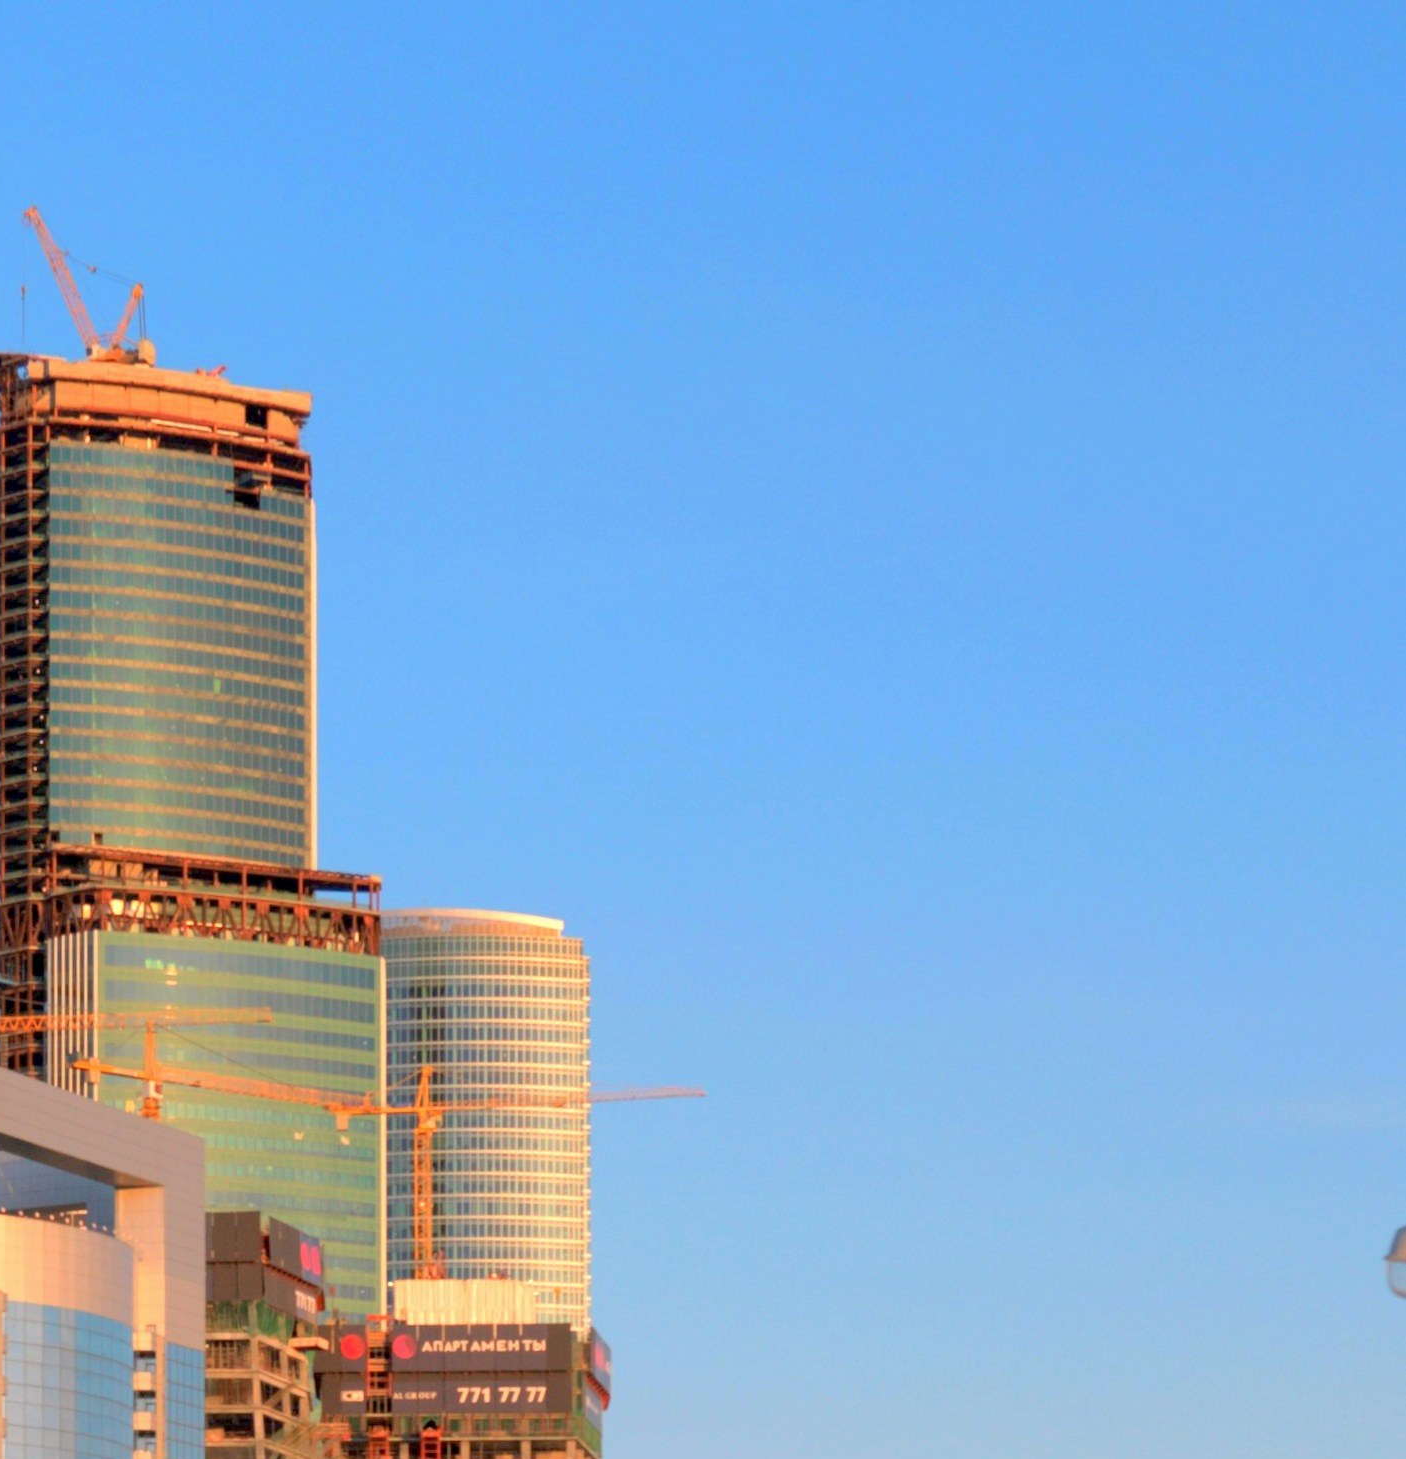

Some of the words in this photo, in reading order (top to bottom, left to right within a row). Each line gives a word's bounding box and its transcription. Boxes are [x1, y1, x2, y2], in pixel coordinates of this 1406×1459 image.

[457, 1386, 491, 1404] 771
[498, 1386, 521, 1404] 77
[526, 1386, 547, 1404] 77
